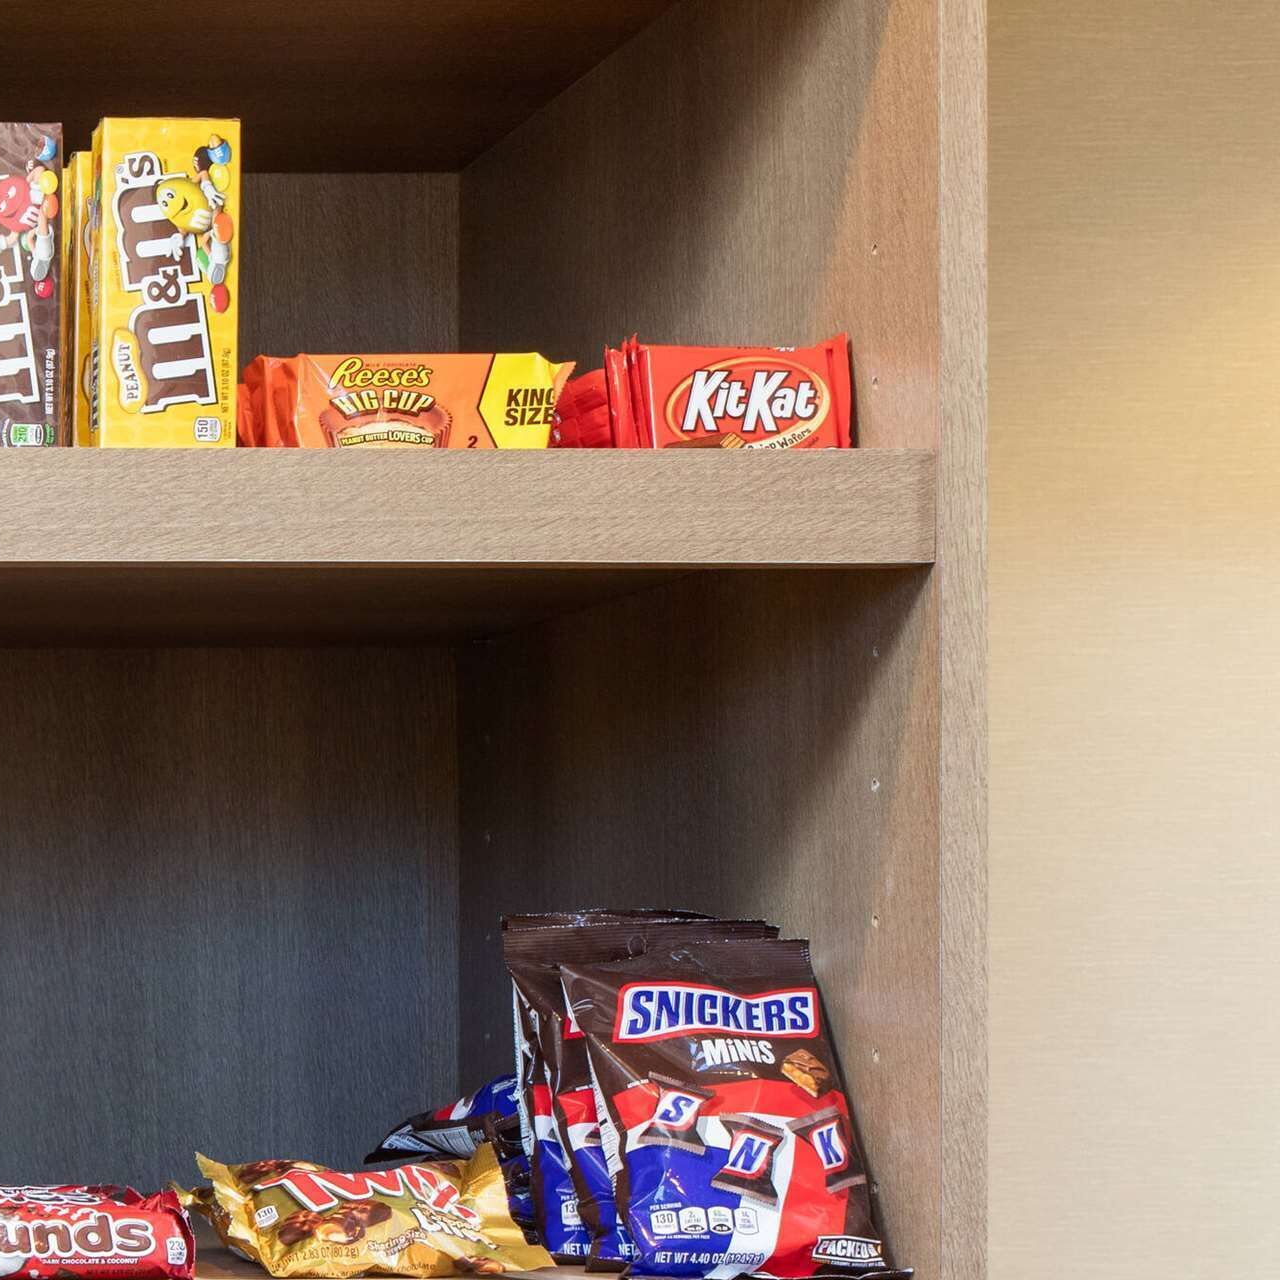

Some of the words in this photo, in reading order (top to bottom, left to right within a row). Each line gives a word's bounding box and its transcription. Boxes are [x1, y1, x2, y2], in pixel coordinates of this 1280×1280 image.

[117, 343, 139, 400] PEANUT
[329, 357, 433, 389] Reese's
[331, 389, 380, 419] BIG
[383, 389, 437, 417] CUP
[504, 407, 556, 427] SIZE
[197, 420, 208, 440] 150
[365, 431, 388, 441] BUTTER
[388, 430, 421, 445] LOVERS
[421, 435, 434, 445] CUP
[777, 427, 812, 449] Wafers
[467, 436, 478, 449] 2
[627, 990, 811, 1036] SNICKERS
[659, 1093, 693, 1121] S
[731, 1137, 765, 1171] N
[821, 1127, 842, 1165] K
[257, 1207, 274, 1219] 130
[655, 1213, 674, 1225] 130
[564, 1243, 583, 1255] NET
[654, 1252, 673, 1264] NET
[674, 1252, 688, 1264] WT
[690, 1252, 710, 1264] 4.40
[712, 1252, 726, 1265] OZ
[107, 1257, 139, 1265] COCONUT
